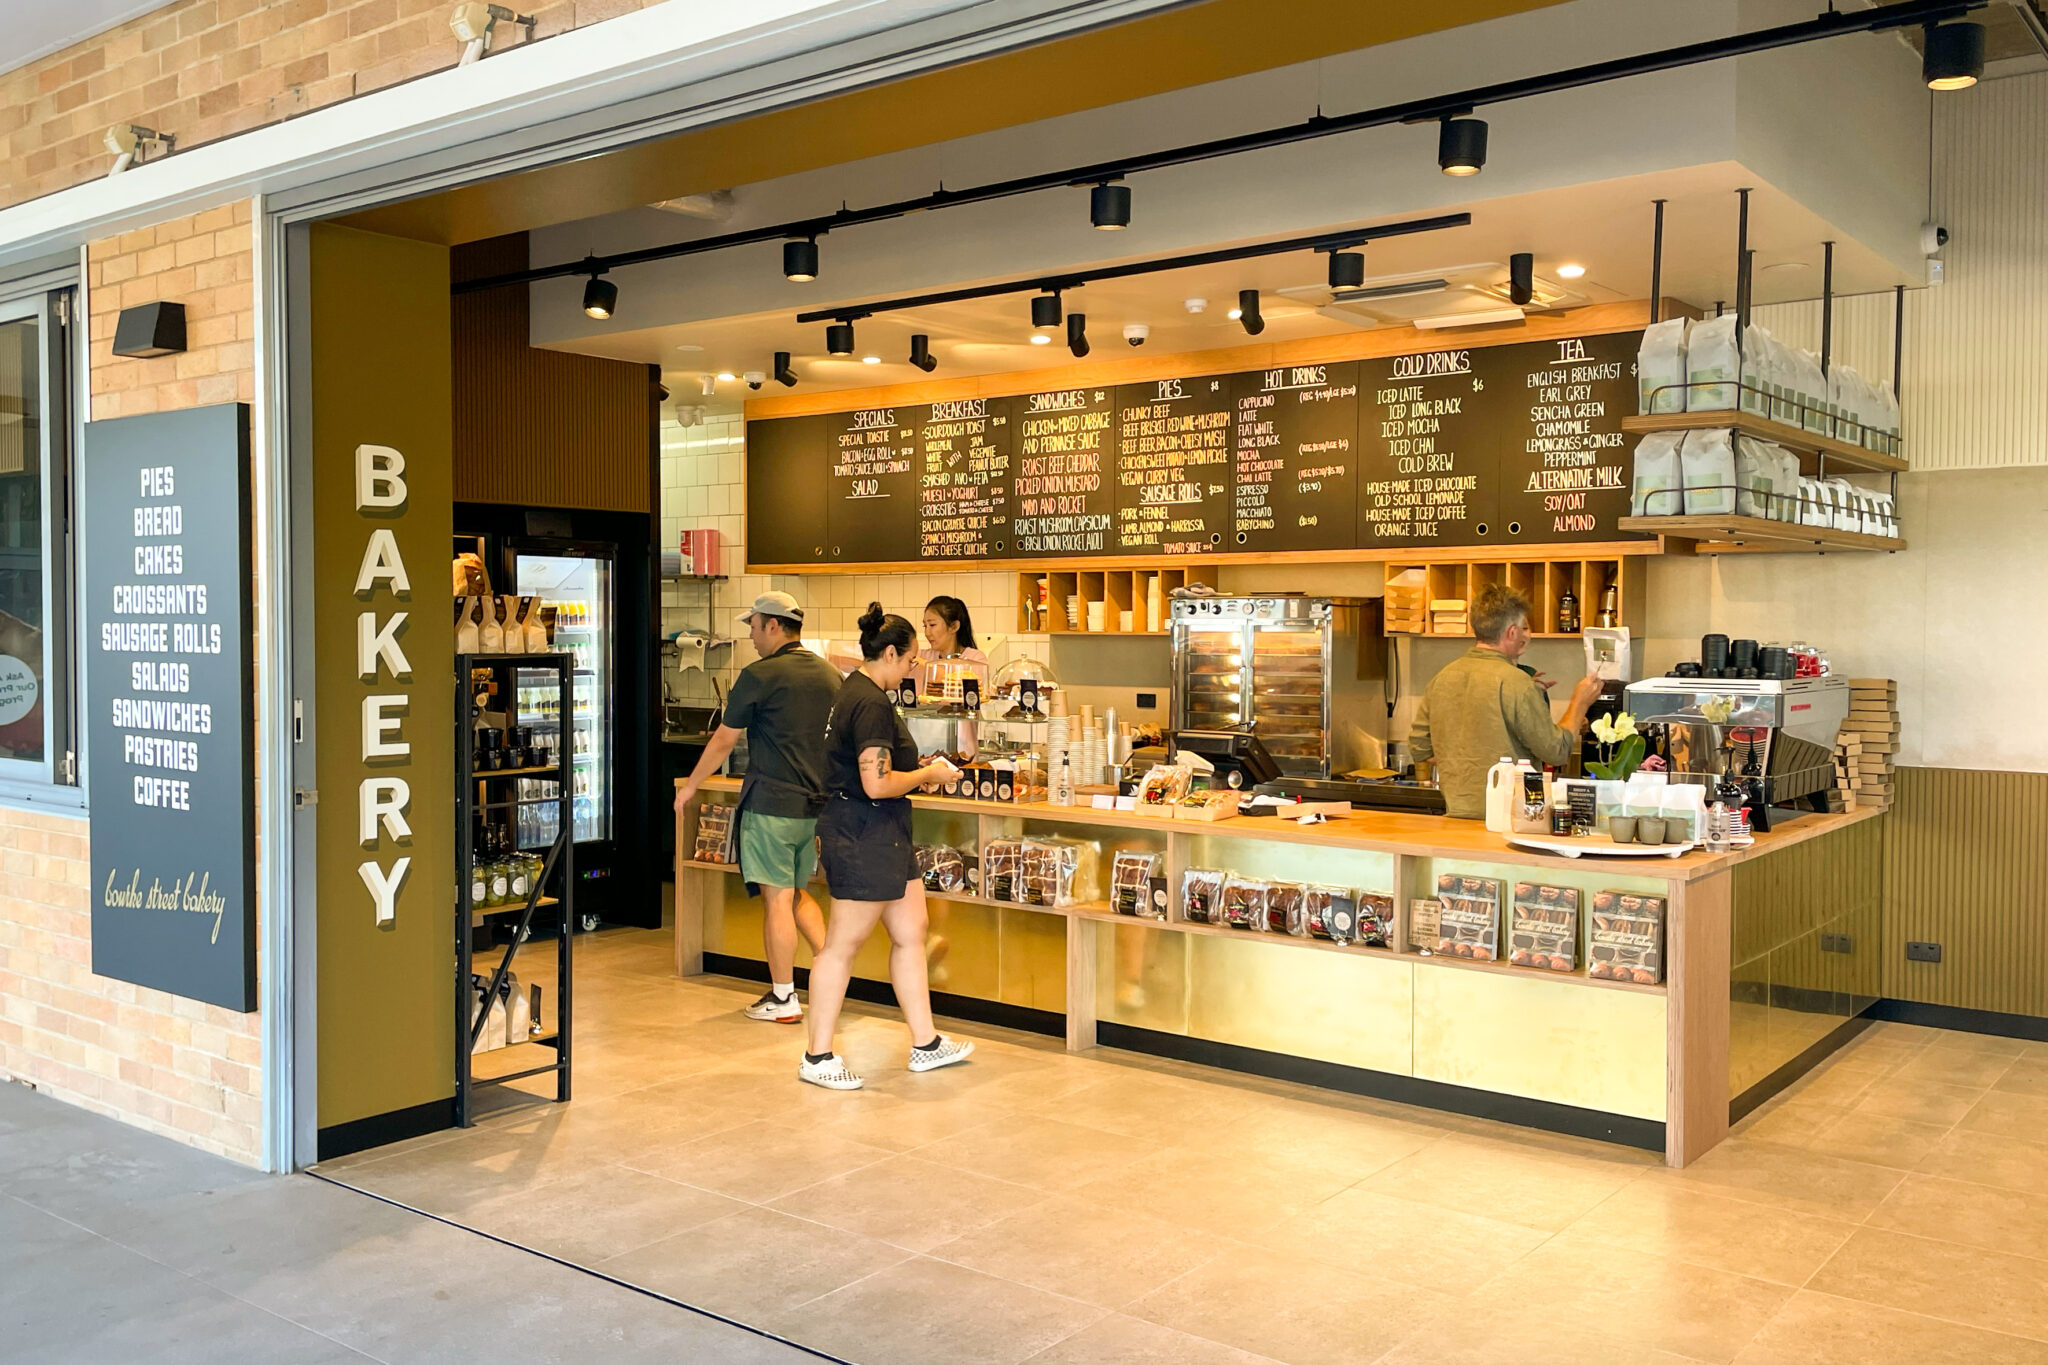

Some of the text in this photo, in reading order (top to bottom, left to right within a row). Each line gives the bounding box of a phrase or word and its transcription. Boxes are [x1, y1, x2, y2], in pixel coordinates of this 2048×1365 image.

[1557, 339, 1585, 360] TEA
[1393, 351, 1470, 377] COLD DRINKS
[1265, 366, 1326, 388] HOT DRINKS
[1527, 370, 1567, 388] ENGLISH
[1572, 362, 1622, 383] BREAKFAST
[1158, 379, 1219, 398] PIES $8
[1472, 377, 1484, 392] $6
[1029, 390, 1085, 411] SANDWICHES
[1377, 386, 1424, 405] ICED LATTE
[1540, 385, 1591, 403] EARL GREY
[931, 399, 987, 420] BREAKFAST
[1122, 404, 1171, 422] CHUNKY BEEF
[1239, 409, 1257, 423] LATTE
[1389, 397, 1462, 420] ICED LONG BLACK
[1530, 401, 1605, 422] SENCHA GREEN
[854, 409, 894, 428] SPECIALS
[1022, 411, 1111, 437] CHICKEN MIXED CABBAGE
[924, 422, 964, 439] SOURDOUGH
[966, 420, 986, 435] TOAST
[1122, 422, 1139, 437] BEEF
[1238, 421, 1273, 436] FLAT WHITE
[1381, 418, 1440, 438] ICED MOCHA
[1536, 420, 1591, 438] CHAMOMILE
[838, 433, 863, 447] SPECIAL
[867, 430, 889, 444] TOASTIE
[970, 436, 983, 447] JAM
[1022, 431, 1100, 455] AND SAUCE
[1204, 430, 1226, 447] MASH
[1238, 434, 1280, 449] LONG BLACK
[1389, 437, 1434, 456] ICED CHAI
[1526, 433, 1624, 453] LEMONGRASS GINGER
[864, 448, 875, 462] EGG
[877, 447, 891, 460] ROLL
[946, 450, 962, 468] WITH
[1236, 450, 1260, 461] MOCHA
[1399, 452, 1454, 474] COLD BREW
[1544, 450, 1597, 467] PEPPERMINT
[1022, 457, 1047, 476] ROAST
[1236, 459, 1284, 473] HOT CHOCOLATE
[140, 466, 175, 497] PIES
[922, 473, 950, 487] SMASHED
[955, 472, 967, 486] AVO
[974, 471, 988, 485] FETA
[1015, 477, 1041, 496] PICKLED
[1066, 474, 1100, 492] MUSTARD
[1120, 468, 1185, 486] VEGAN CURRY VEG
[1236, 471, 1272, 483] CHAI LATTE
[1414, 475, 1477, 492] ICED CHOCOLATE
[1527, 466, 1623, 490] ALTERNATIVE MILK
[852, 479, 878, 496] SALAD
[923, 489, 946, 502] MUESLI
[1140, 482, 1202, 502] SAUSAGE ROLLS
[1236, 484, 1269, 496] ESPRESSO
[1040, 497, 1056, 515] AND
[1058, 495, 1086, 515] ROCKET
[1236, 495, 1265, 507] PICCOLO
[1374, 491, 1464, 507] OLD SCHOOL LEMONADE
[1544, 493, 1586, 513] SOY/OAT
[134, 505, 183, 537] BREAD
[1121, 506, 1169, 520] PORK FENNEL
[1236, 507, 1272, 518] MACCHIATO
[1415, 505, 1466, 521] ICED COFFEE
[967, 516, 987, 529] QUICHE
[1015, 518, 1037, 536] ROAST
[1139, 521, 1164, 534] ALMOND
[1236, 519, 1275, 531] BABYCHINO
[1374, 522, 1438, 537] ORANGE JUICE
[1553, 514, 1596, 533] ALMOND
[1121, 533, 1159, 546] VEGAN ROLL
[1163, 542, 1185, 554] TOMATO
[1186, 542, 1201, 553] SAUCE
[941, 544, 962, 556] CHEESE
[964, 543, 988, 556] QUICHE
[134, 545, 183, 575] CAKES
[113, 584, 207, 615] CROISSANTS
[102, 622, 221, 654] SAUSAGE ROLLS
[132, 661, 190, 693] SALADS
[353, 443, 413, 928] BAKERY
[112, 698, 212, 735] SANDWICHES
[124, 734, 199, 773] PASTRIES
[134, 775, 190, 811] COFFEE
[104, 867, 226, 945] bourke street bakery
